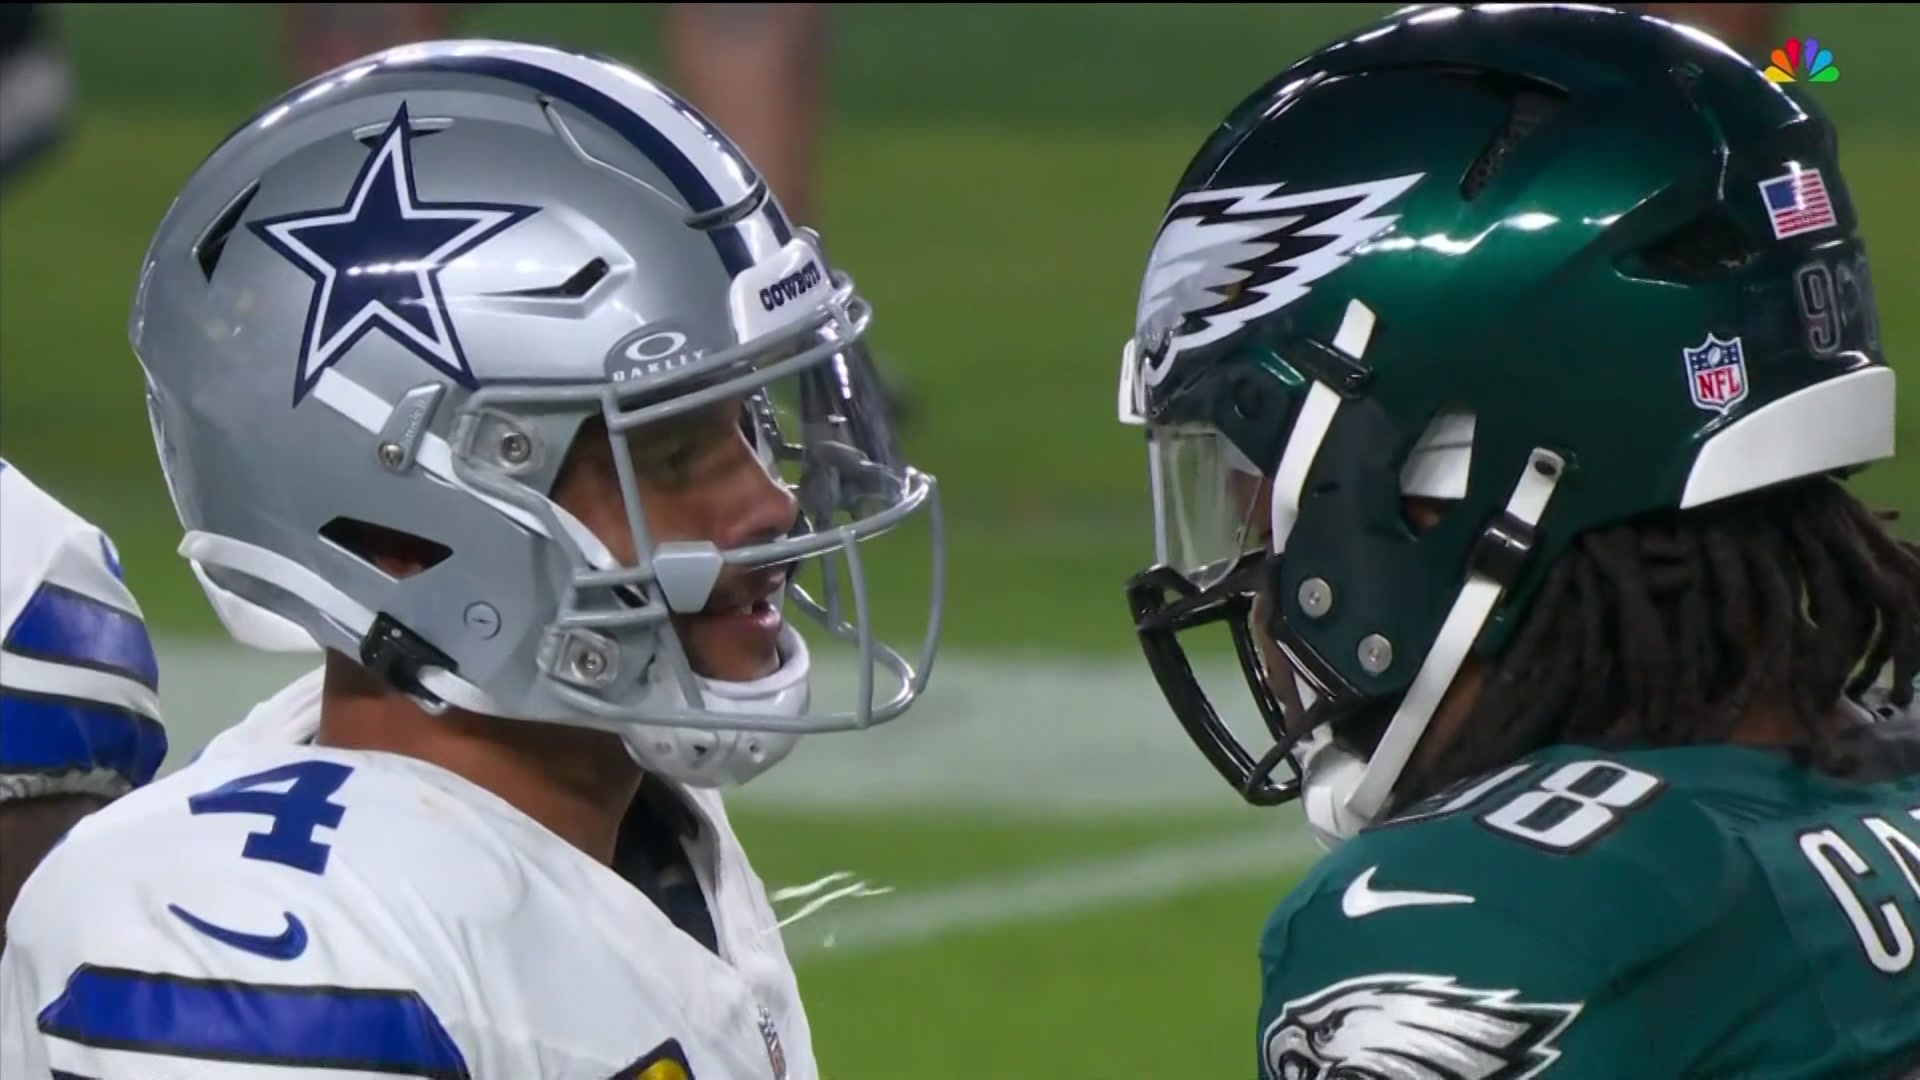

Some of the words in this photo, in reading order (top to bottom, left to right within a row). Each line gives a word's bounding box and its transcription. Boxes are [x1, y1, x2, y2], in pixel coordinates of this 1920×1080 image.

[612, 349, 704, 382] OAKLEY
[1696, 367, 1741, 401] NFL
[187, 760, 355, 876] 4
